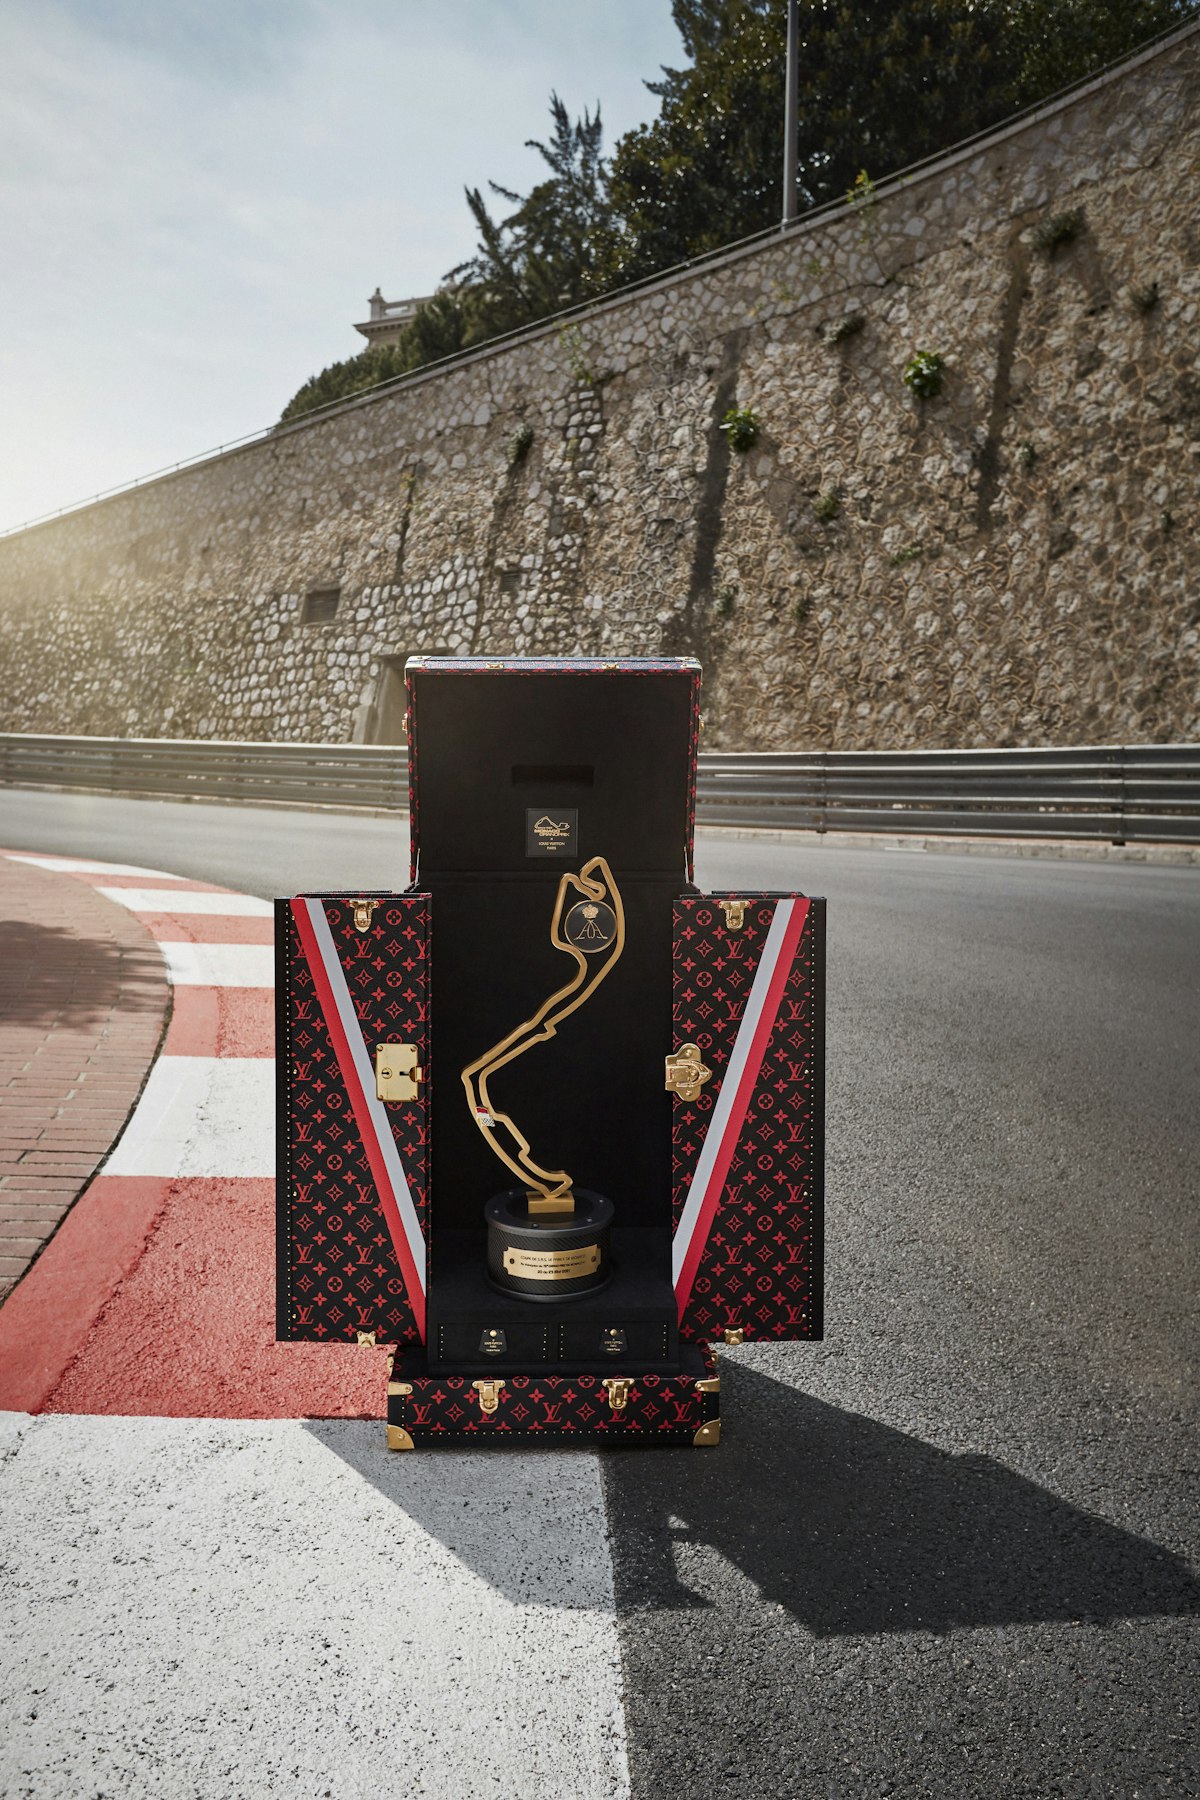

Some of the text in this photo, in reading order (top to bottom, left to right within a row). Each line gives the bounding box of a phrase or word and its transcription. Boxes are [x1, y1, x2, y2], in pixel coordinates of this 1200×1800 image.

[354, 938, 372, 958] LV
[726, 939, 743, 958] LV
[294, 1000, 312, 1019] LV
[354, 1000, 372, 1020] LV
[726, 1001, 742, 1020] LV
[788, 1000, 804, 1020] LV
[296, 1061, 312, 1080] LV
[788, 1062, 804, 1081] LV
[296, 1122, 313, 1142] LV
[788, 1122, 804, 1142] LV
[296, 1183, 313, 1202] LV
[356, 1184, 372, 1204] LV
[726, 1184, 743, 1204] LV
[787, 1184, 803, 1203] LV
[296, 1244, 313, 1263] LV
[356, 1245, 374, 1264] LV
[725, 1245, 742, 1264] LV
[786, 1244, 803, 1263] LV
[296, 1305, 313, 1324] LV
[356, 1306, 373, 1325] LV
[725, 1306, 741, 1324] LV
[786, 1305, 802, 1323] LV
[413, 1404, 431, 1424] LV
[543, 1402, 561, 1422] LV
[674, 1402, 691, 1421] LV
